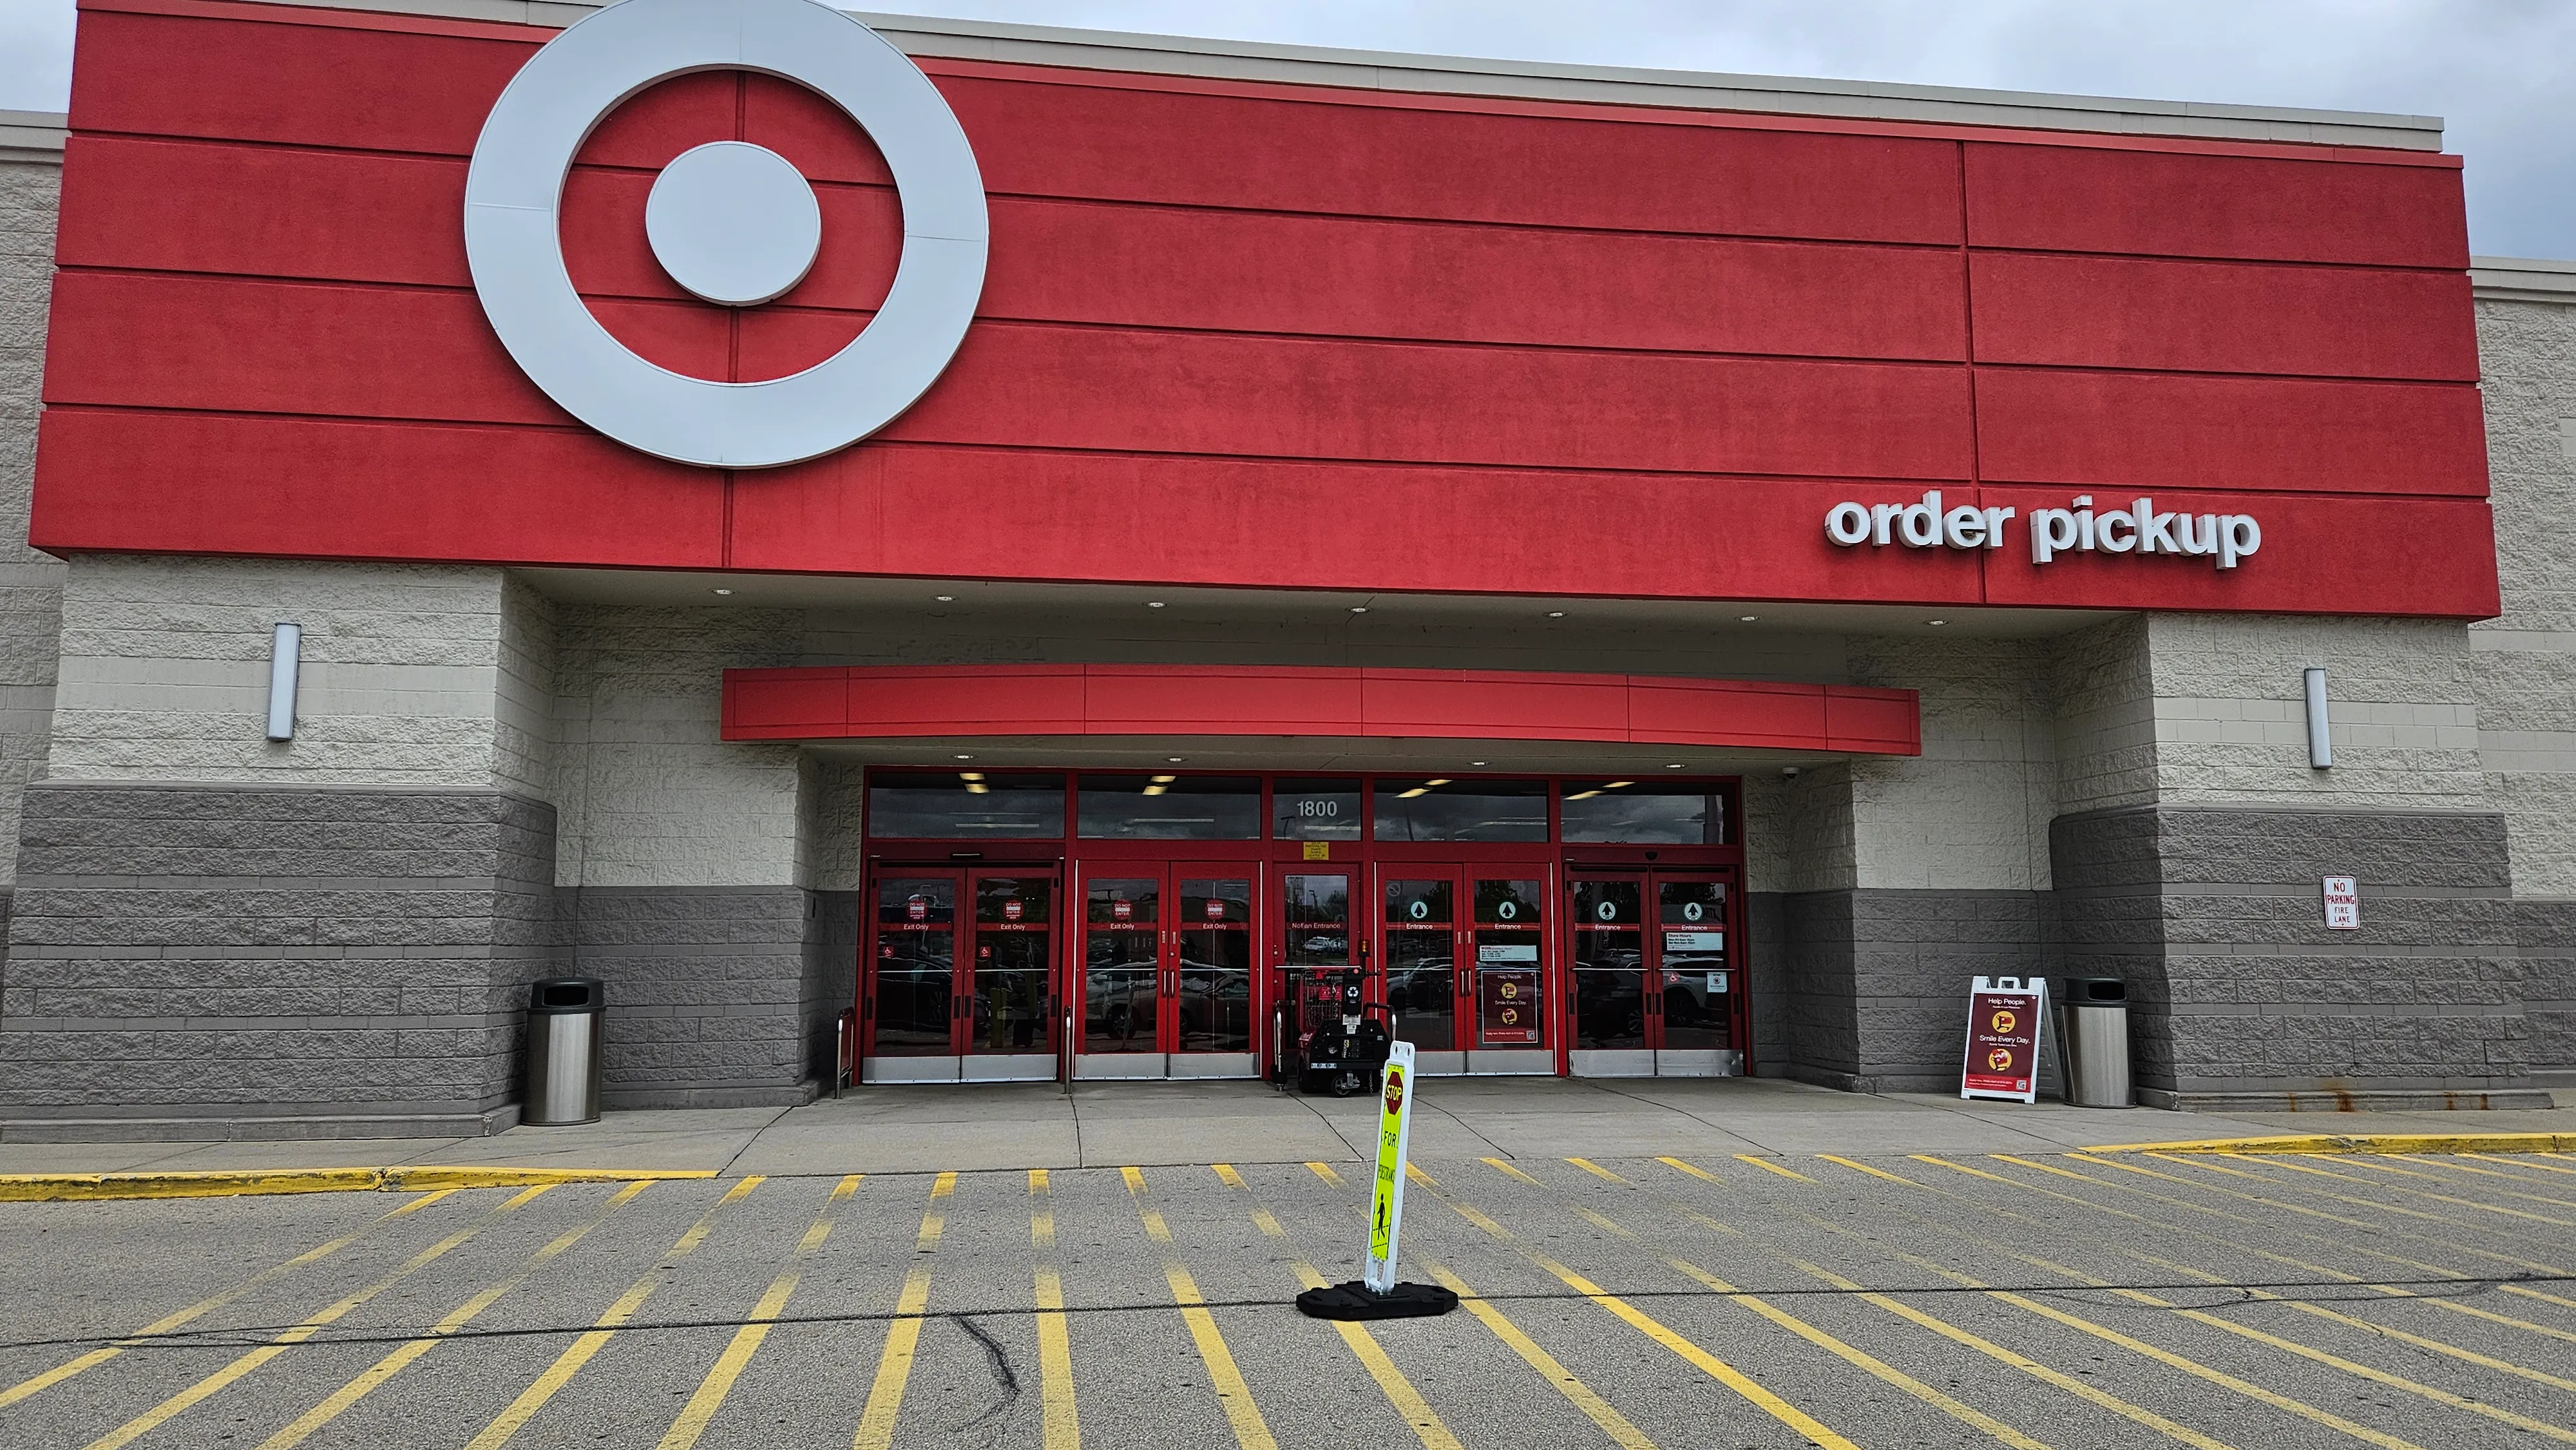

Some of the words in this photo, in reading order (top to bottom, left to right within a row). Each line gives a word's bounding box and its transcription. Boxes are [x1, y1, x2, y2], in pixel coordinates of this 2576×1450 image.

[1825, 490, 2016, 549] order
[2030, 495, 2262, 569] pickup
[1297, 801, 1337, 817] 1800
[2334, 882, 2345, 892] NO
[2327, 894, 2354, 904] PARKING
[1386, 1084, 1402, 1101] STOP
[1384, 1130, 1397, 1148] FOR
